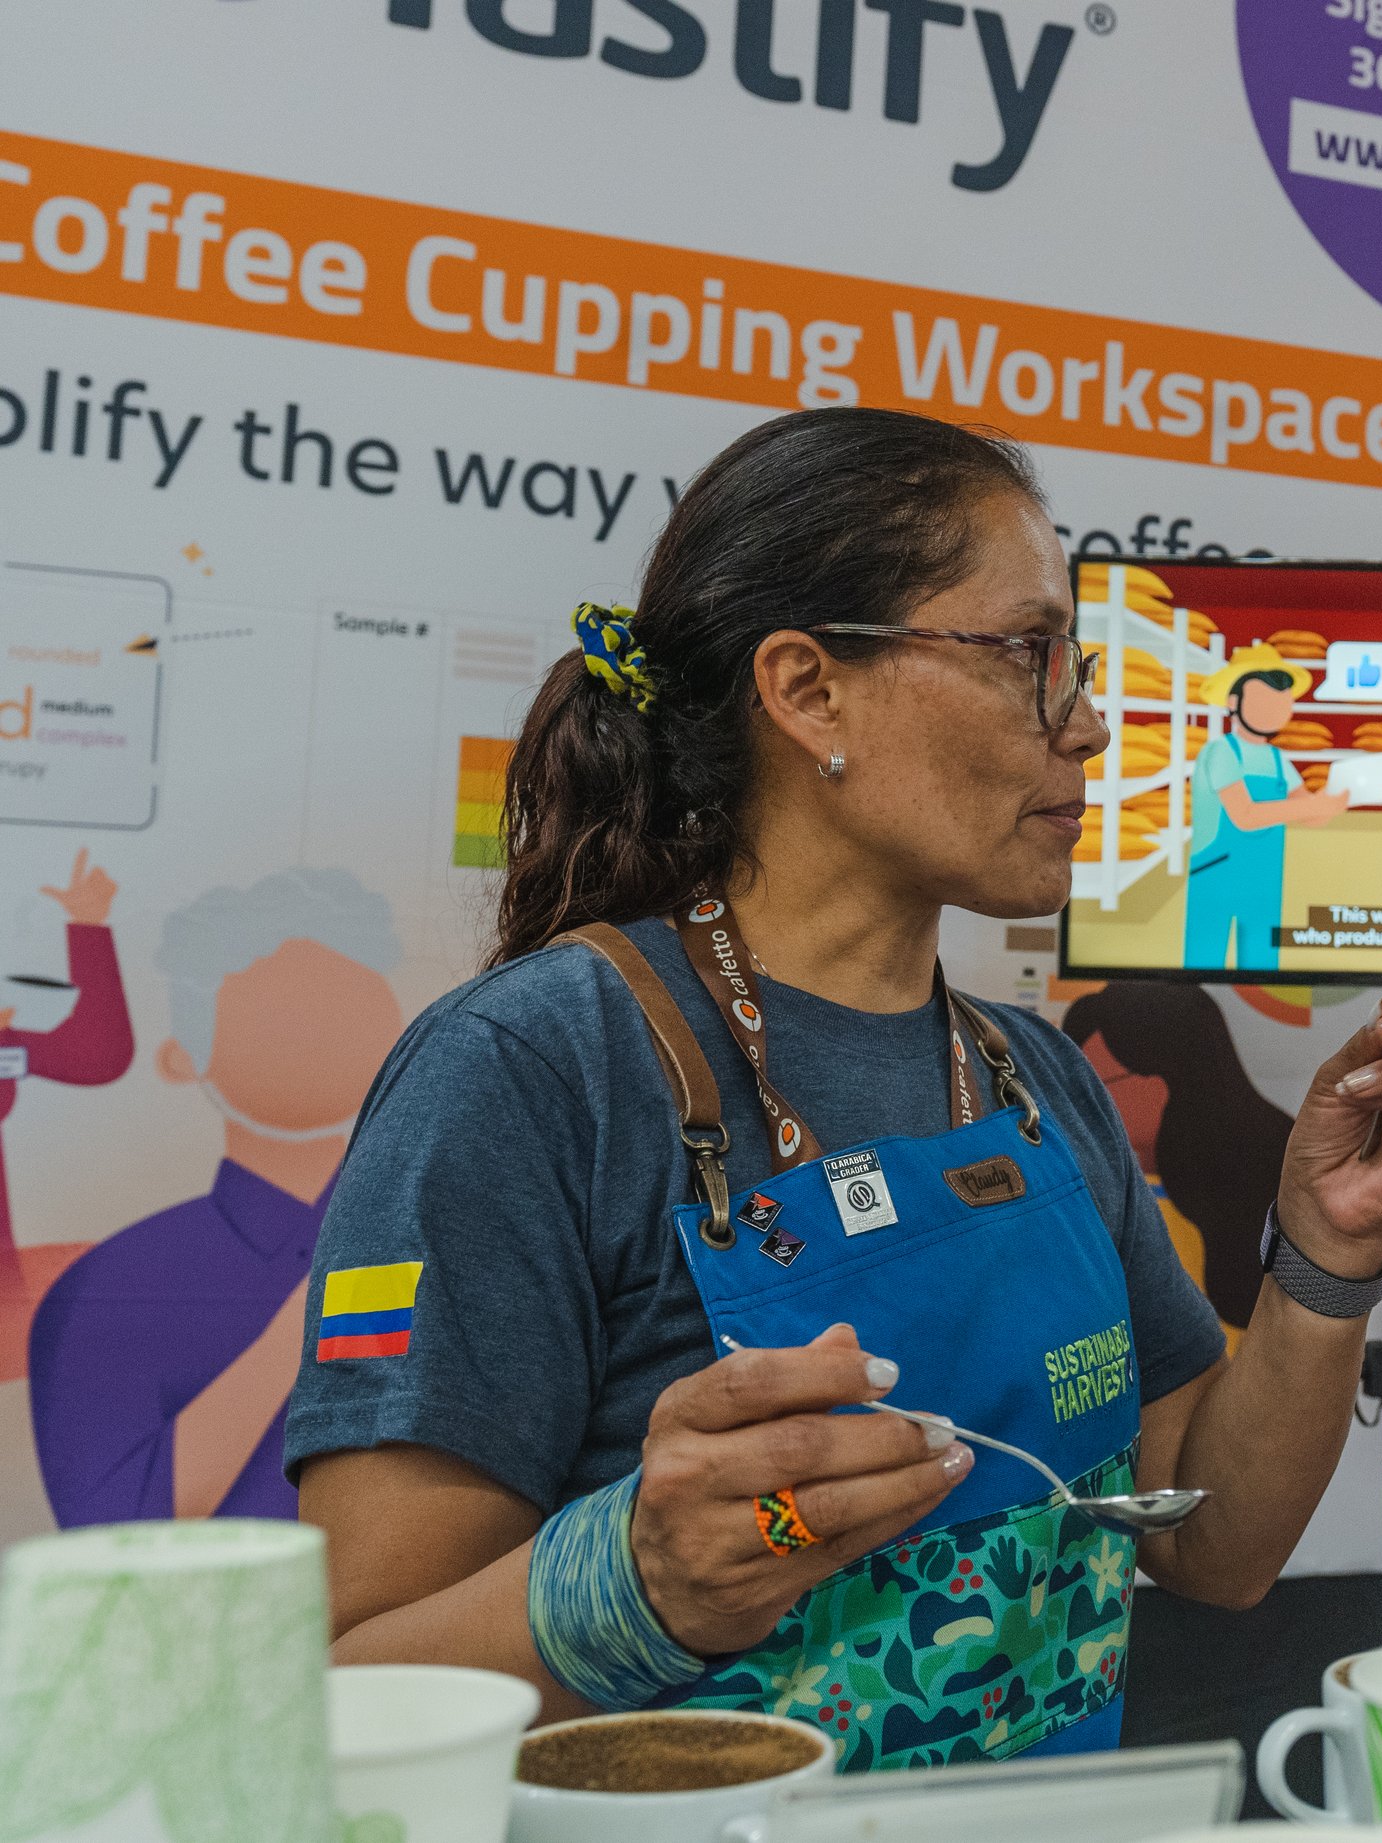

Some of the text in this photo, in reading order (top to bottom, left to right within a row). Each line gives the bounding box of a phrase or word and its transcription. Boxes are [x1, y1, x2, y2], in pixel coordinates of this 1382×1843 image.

[406, 235, 862, 410] Cupping
[234, 403, 400, 495] the
[434, 447, 637, 544] way
[1292, 926, 1332, 945] who
[1328, 905, 1369, 924] This
[711, 929, 750, 997] cafetto
[838, 1153, 873, 1168] ARABICA
[839, 1163, 870, 1178] GRADER
[1051, 1357, 1127, 1424] HARVEST
